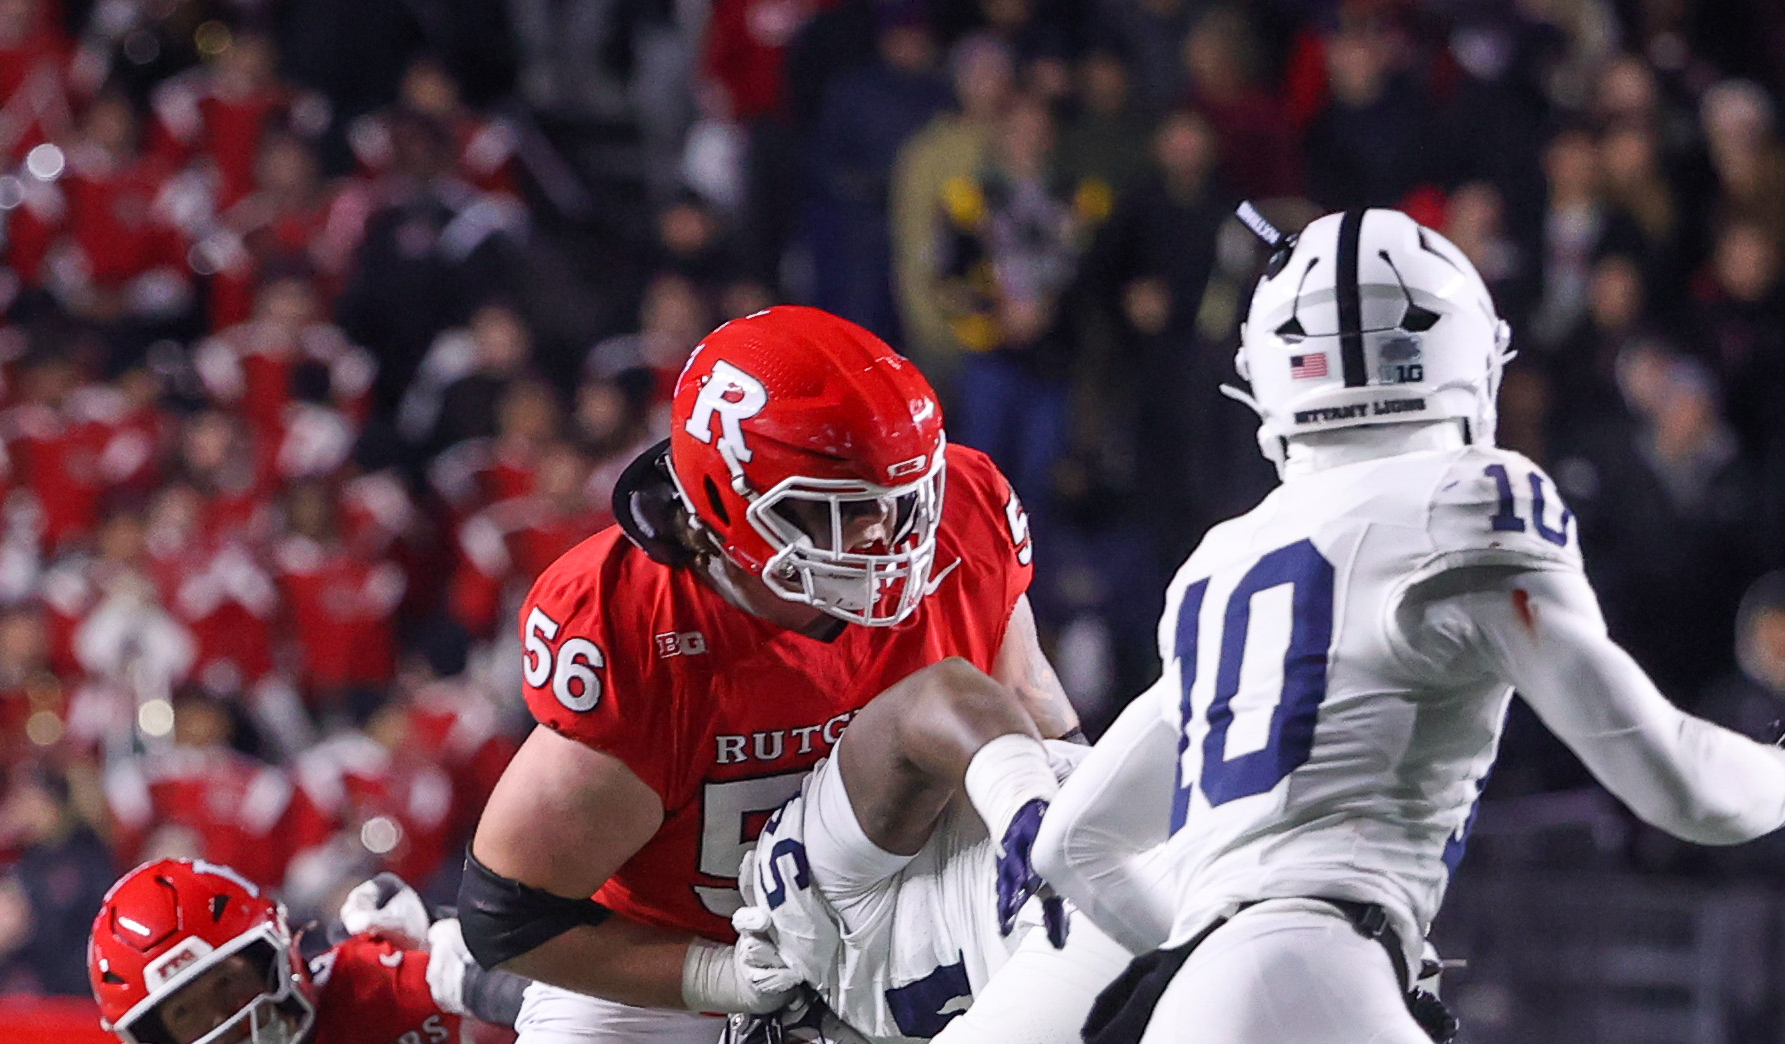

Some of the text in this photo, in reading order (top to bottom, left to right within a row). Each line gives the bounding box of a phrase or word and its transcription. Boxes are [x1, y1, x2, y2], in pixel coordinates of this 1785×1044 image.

[685, 358, 768, 463] R
[1483, 463, 1579, 548] 10
[523, 607, 605, 713] 56
[1168, 537, 1335, 842] 10
[715, 707, 860, 765] RUTG
